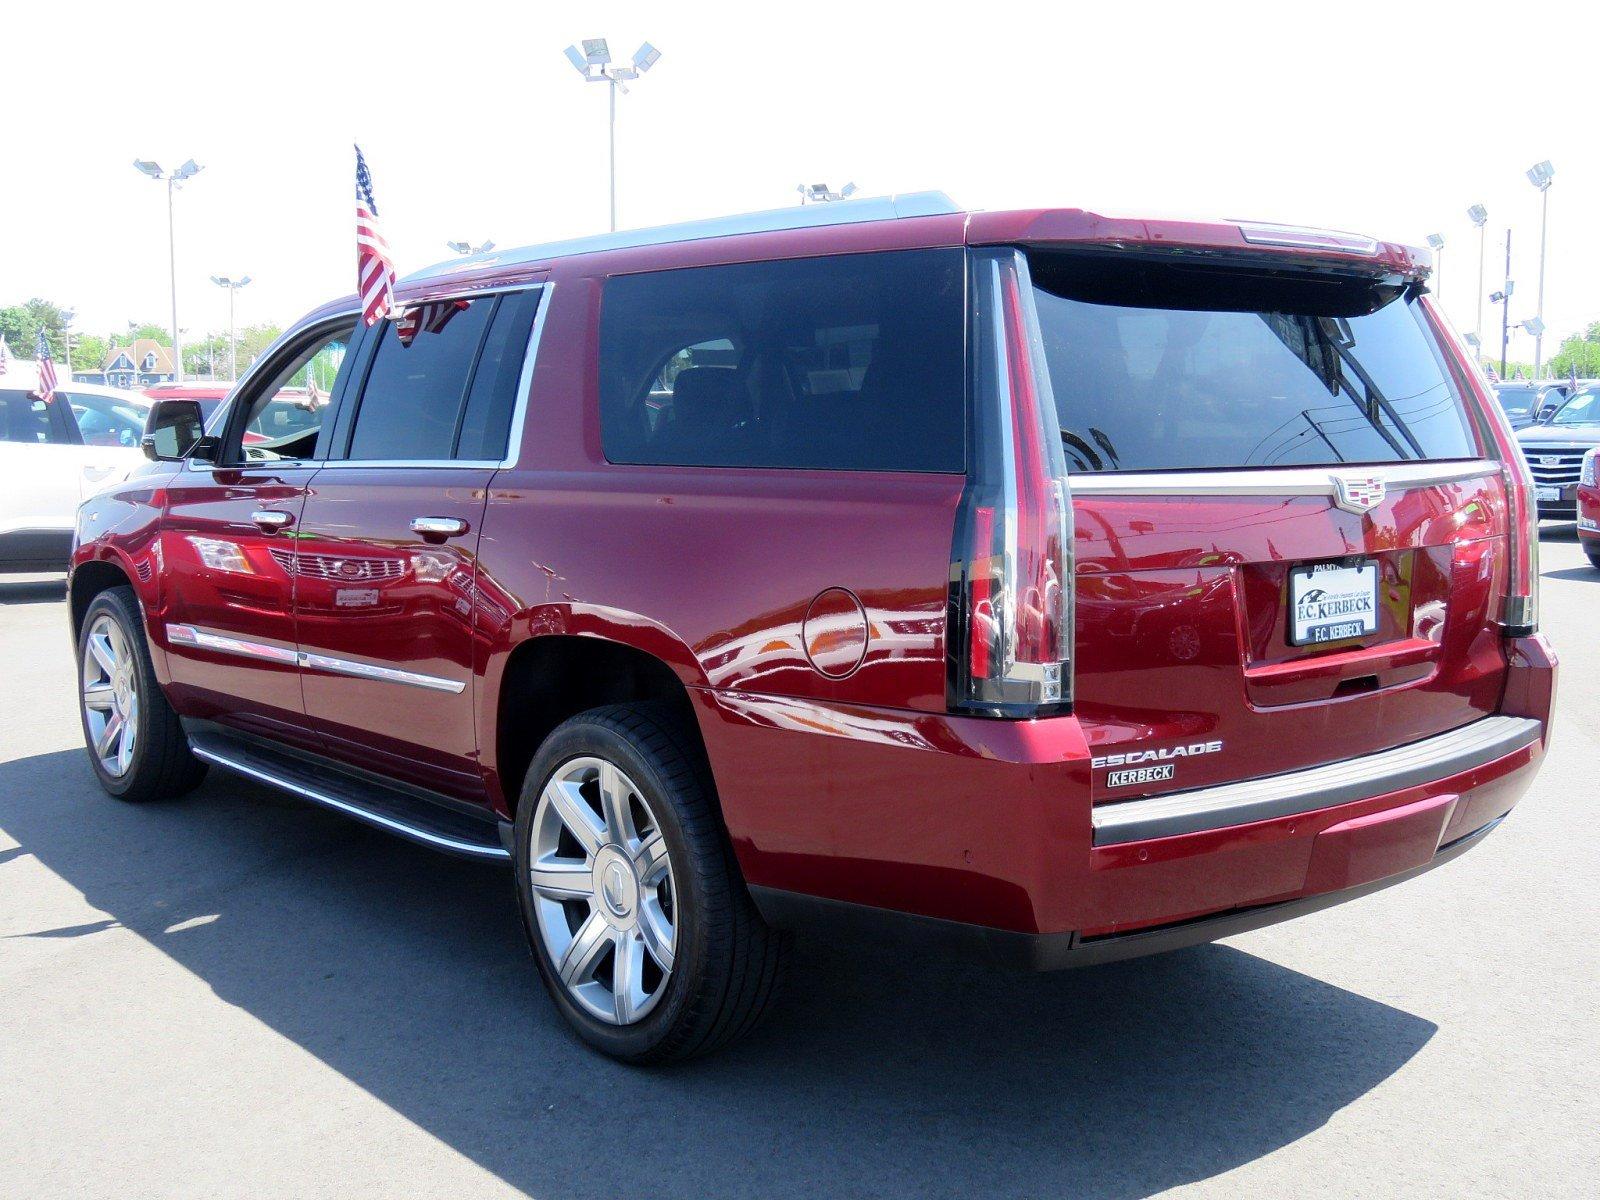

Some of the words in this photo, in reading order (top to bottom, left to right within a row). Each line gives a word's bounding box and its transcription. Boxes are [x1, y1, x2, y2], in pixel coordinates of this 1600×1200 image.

[1298, 605, 1316, 619] F.C.
[1318, 598, 1371, 618] KERBECK
[1315, 628, 1328, 641] F.C.
[1330, 623, 1361, 638] KERBECK
[1091, 740, 1222, 768] ESCALADE
[1111, 766, 1171, 786] KERBECK
